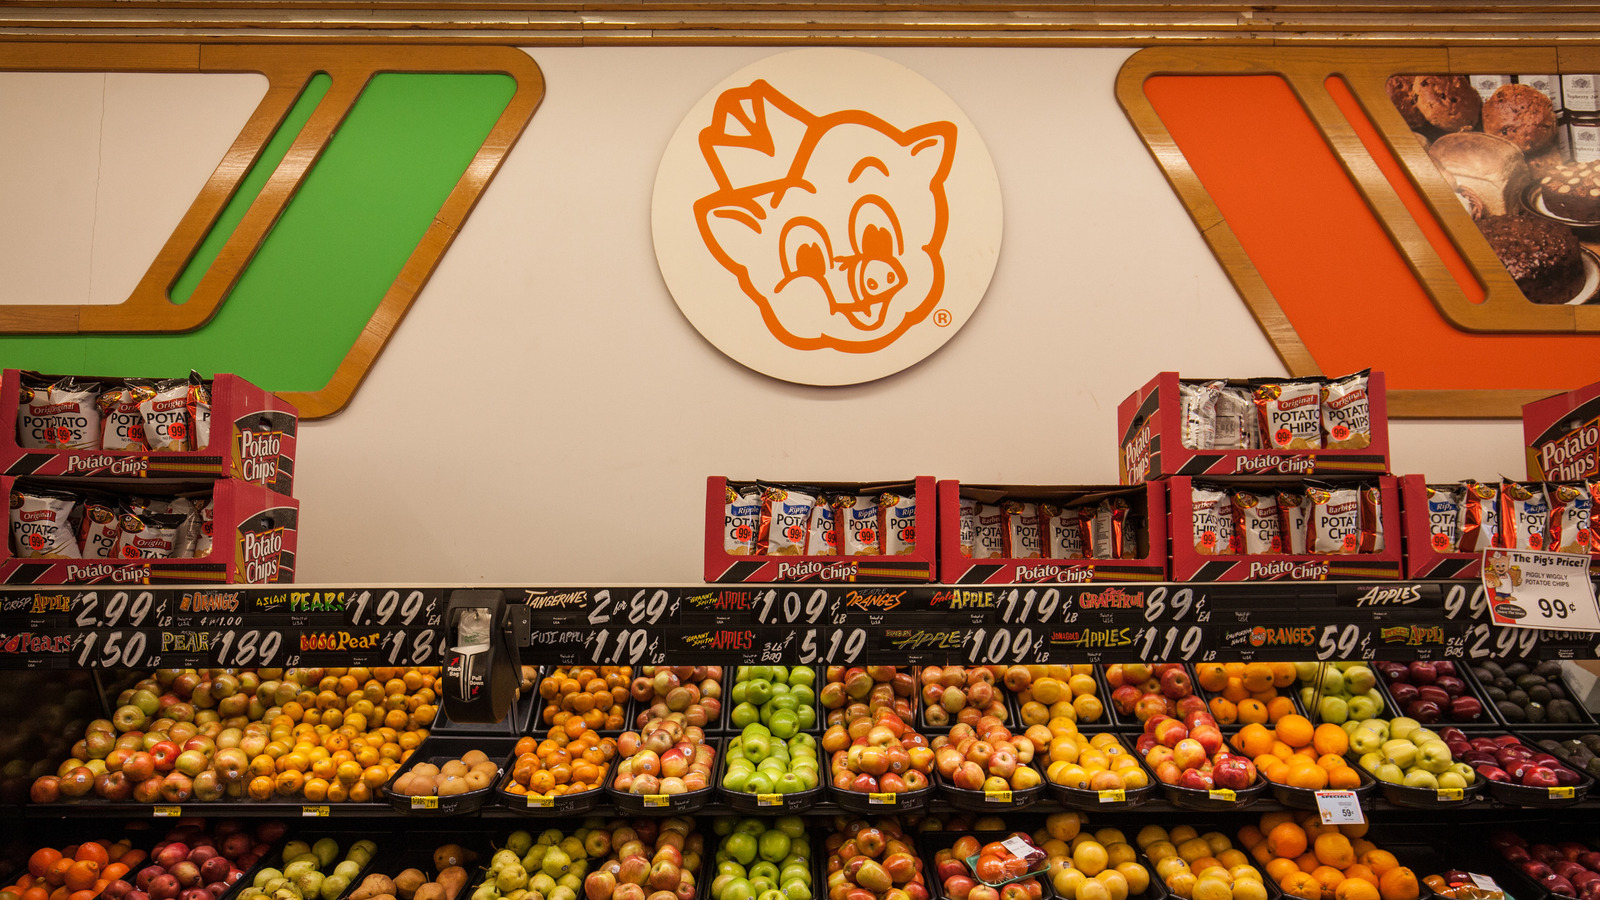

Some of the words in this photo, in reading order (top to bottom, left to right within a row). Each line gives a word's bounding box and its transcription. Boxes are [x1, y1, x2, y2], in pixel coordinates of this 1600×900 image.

[1281, 395, 1315, 409] Original
[1332, 391, 1363, 408] Original
[242, 430, 280, 458] Potato
[1126, 426, 1151, 472] Potato
[1541, 427, 1599, 472] Potato
[68, 454, 113, 472] Potato
[111, 458, 148, 475] Chips
[243, 456, 275, 485] Chips
[1128, 450, 1149, 485] Chips
[1236, 454, 1280, 472] Potato
[1278, 458, 1315, 473] Chips
[1548, 452, 1595, 481] Chips
[1329, 503, 1357, 514] Barbecu
[777, 514, 804, 526] POTA
[849, 519, 879, 531] POTA
[891, 518, 915, 529] POT
[1321, 516, 1357, 528] POTAT
[1056, 528, 1080, 538] POTA
[244, 532, 282, 562] Potato
[246, 557, 277, 584] Chips
[778, 560, 822, 579] Potato
[820, 564, 857, 580] Chips
[1250, 561, 1294, 578] Potato
[1291, 564, 1328, 580] Chips
[1513, 554, 1531, 563] The
[1533, 555, 1554, 567] Pig's
[1556, 557, 1585, 568] Price!
[67, 563, 113, 580] Potato
[112, 567, 150, 582] Chips
[1016, 564, 1059, 582] Potato
[1057, 568, 1094, 583] Chips
[1525, 571, 1545, 579] PIGGLY
[1525, 578, 1551, 587] POTATOE
[1551, 580, 1570, 588] CHIPS
[29, 593, 71, 613] APPLE
[192, 591, 240, 613] ORANGES
[256, 593, 287, 607] ASIAN
[290, 591, 345, 612] PEARS
[1356, 584, 1421, 607] APPLES
[587, 589, 611, 625] 2
[1197, 611, 1211, 622] EA
[1538, 598, 1577, 619] 99¢
[158, 616, 173, 628] LB
[427, 614, 442, 626] EA
[833, 613, 848, 625] LB
[1064, 612, 1079, 624] LB
[710, 630, 753, 650] APPLES
[892, 630, 961, 650] APPLE
[1075, 627, 1132, 648] APPLES
[20, 632, 71, 653] Pears
[147, 655, 161, 667] LB
[531, 630, 559, 646] FUJI
[651, 652, 666, 665] LB
[1035, 651, 1050, 663] LB
[1202, 650, 1217, 661] LB
[1362, 648, 1377, 660] EA
[285, 655, 300, 667] LB
[761, 652, 782, 663] Bag
